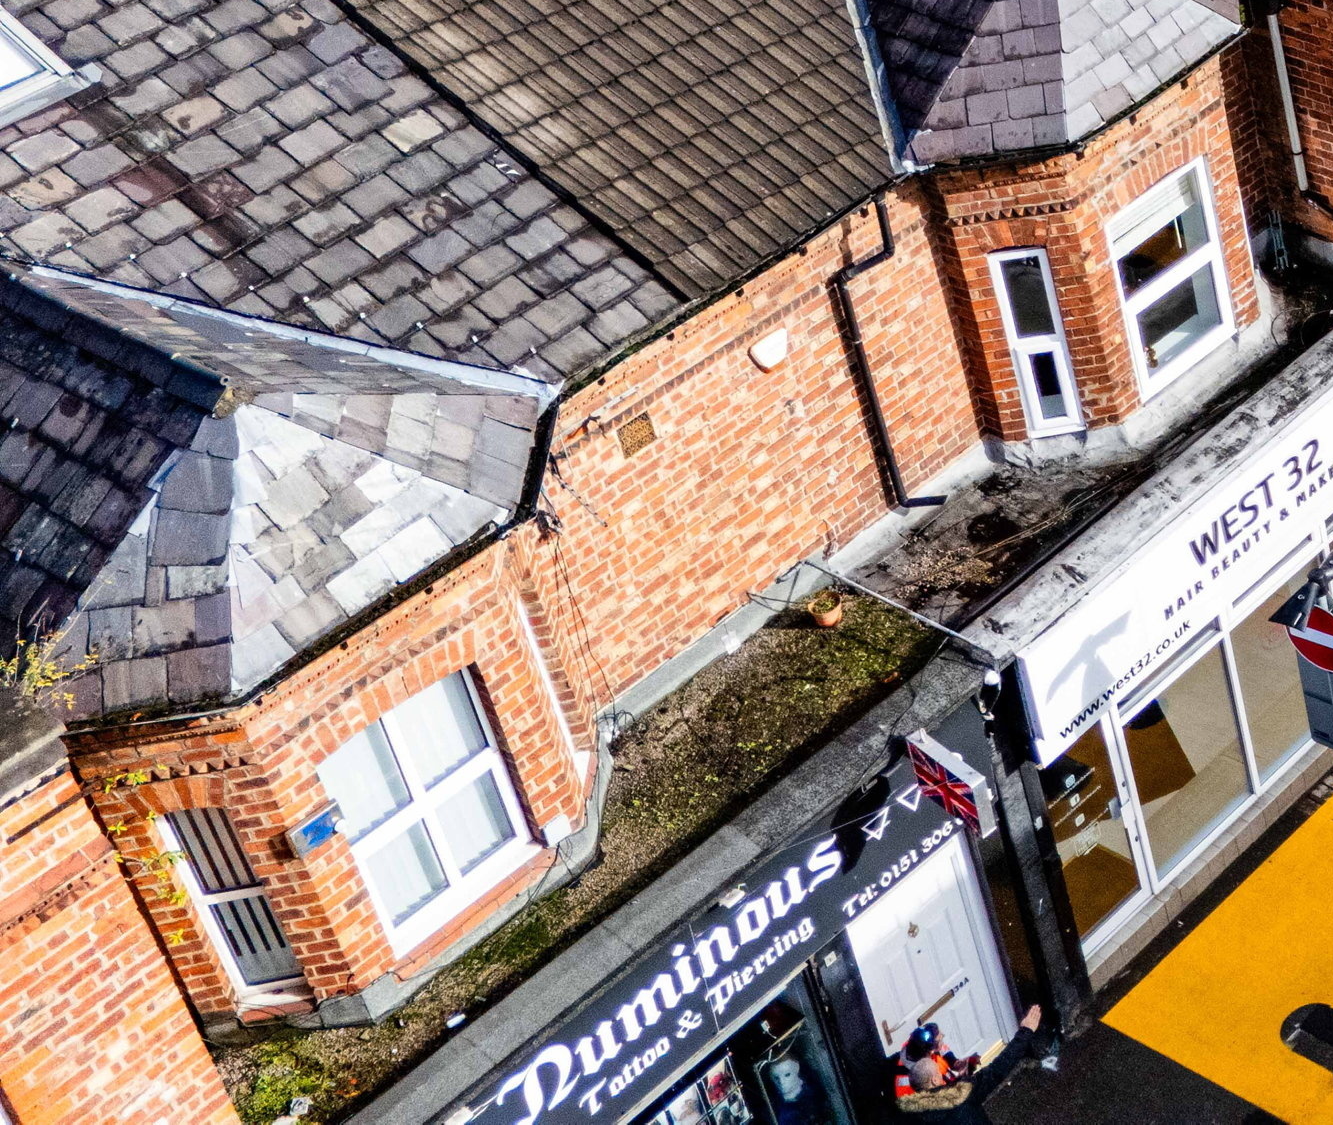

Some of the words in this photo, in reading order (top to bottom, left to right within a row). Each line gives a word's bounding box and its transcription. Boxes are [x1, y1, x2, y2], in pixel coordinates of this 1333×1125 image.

[1188, 472, 1276, 567] WEST
[1284, 438, 1324, 493] 32
[1163, 579, 1205, 621] HAIR
[1211, 520, 1273, 581] BEAUTY
[1279, 508, 1290, 522] &
[1059, 618, 1192, 740] www.west32.co.uk
[842, 883, 879, 918] Tel:
[880, 848, 919, 888] 0151
[921, 820, 954, 854] 306
[578, 1036, 671, 1117] Tattoo
[676, 1010, 703, 1041] &
[704, 916, 815, 1016] Piercing
